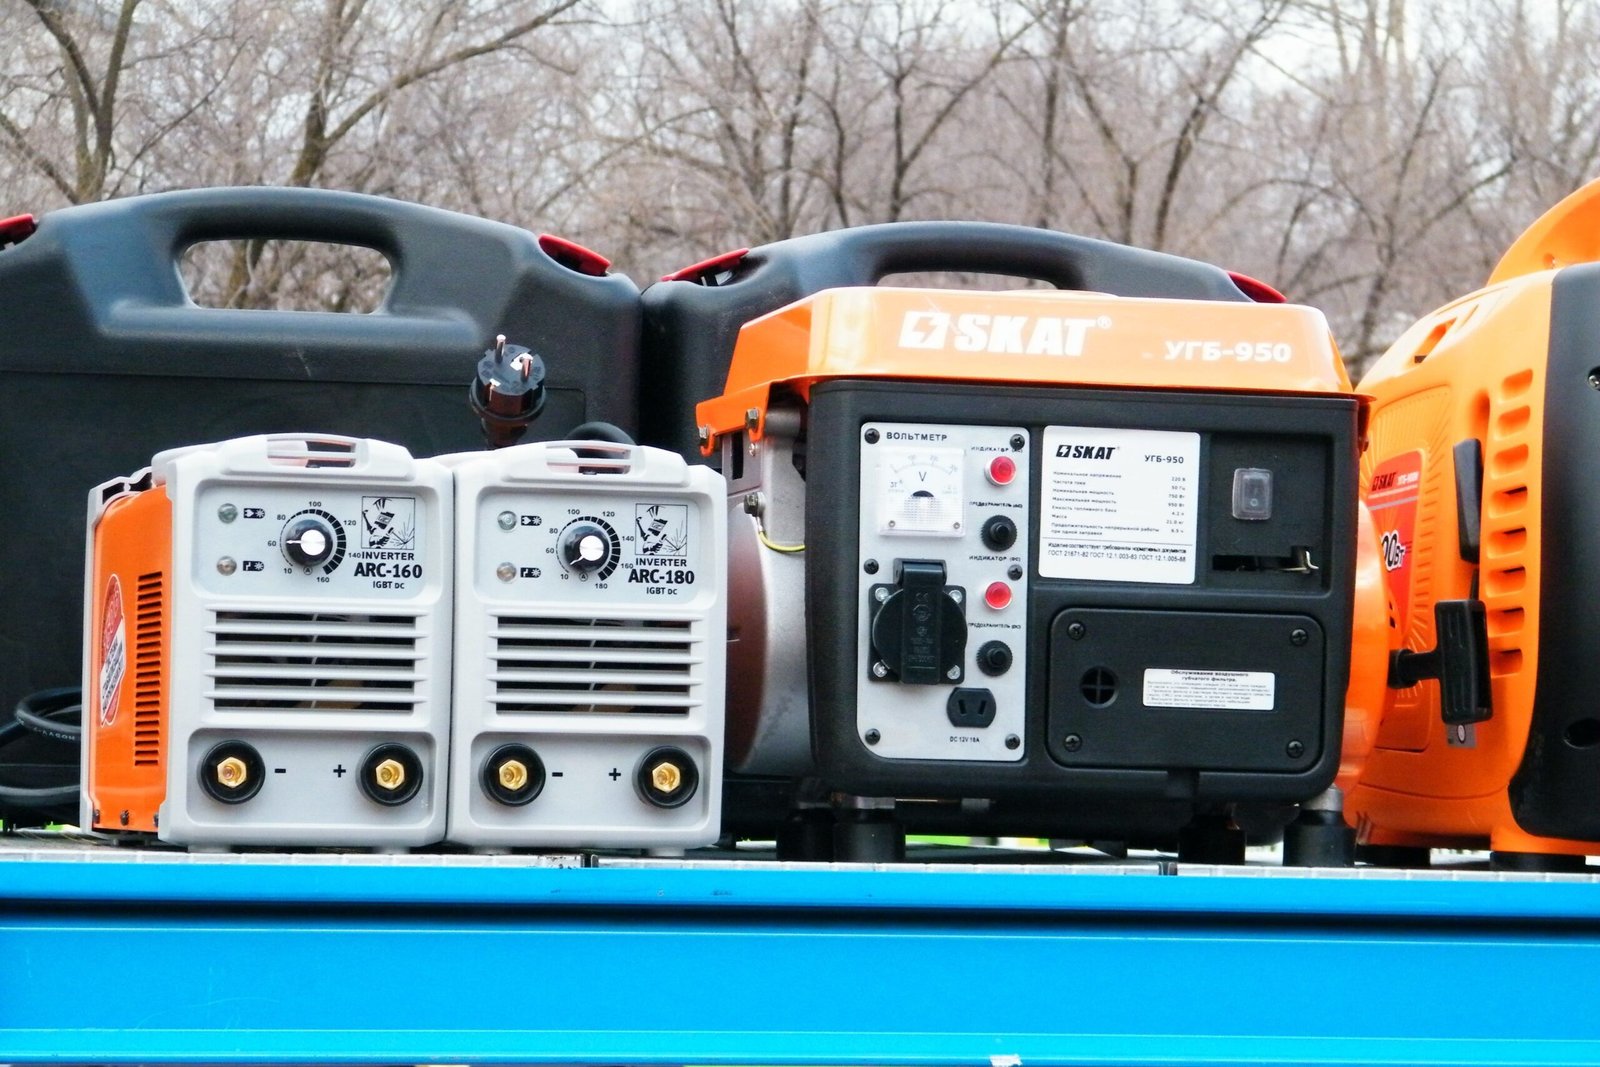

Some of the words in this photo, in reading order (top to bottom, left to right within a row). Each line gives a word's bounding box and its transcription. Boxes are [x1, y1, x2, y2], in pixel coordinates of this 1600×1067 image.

[1164, 340, 1292, 362] УГБ-950
[886, 431, 948, 441] ВОЛЬТМЕТР
[1072, 445, 1116, 460] SKAT
[1144, 454, 1184, 464] УГБ-950
[918, 472, 927, 482] V
[361, 552, 414, 560] INVERTER
[635, 558, 687, 567] INVERTER
[354, 562, 422, 578] ARC-160
[628, 569, 695, 584] ARC-180
[646, 587, 665, 595] IGBT
